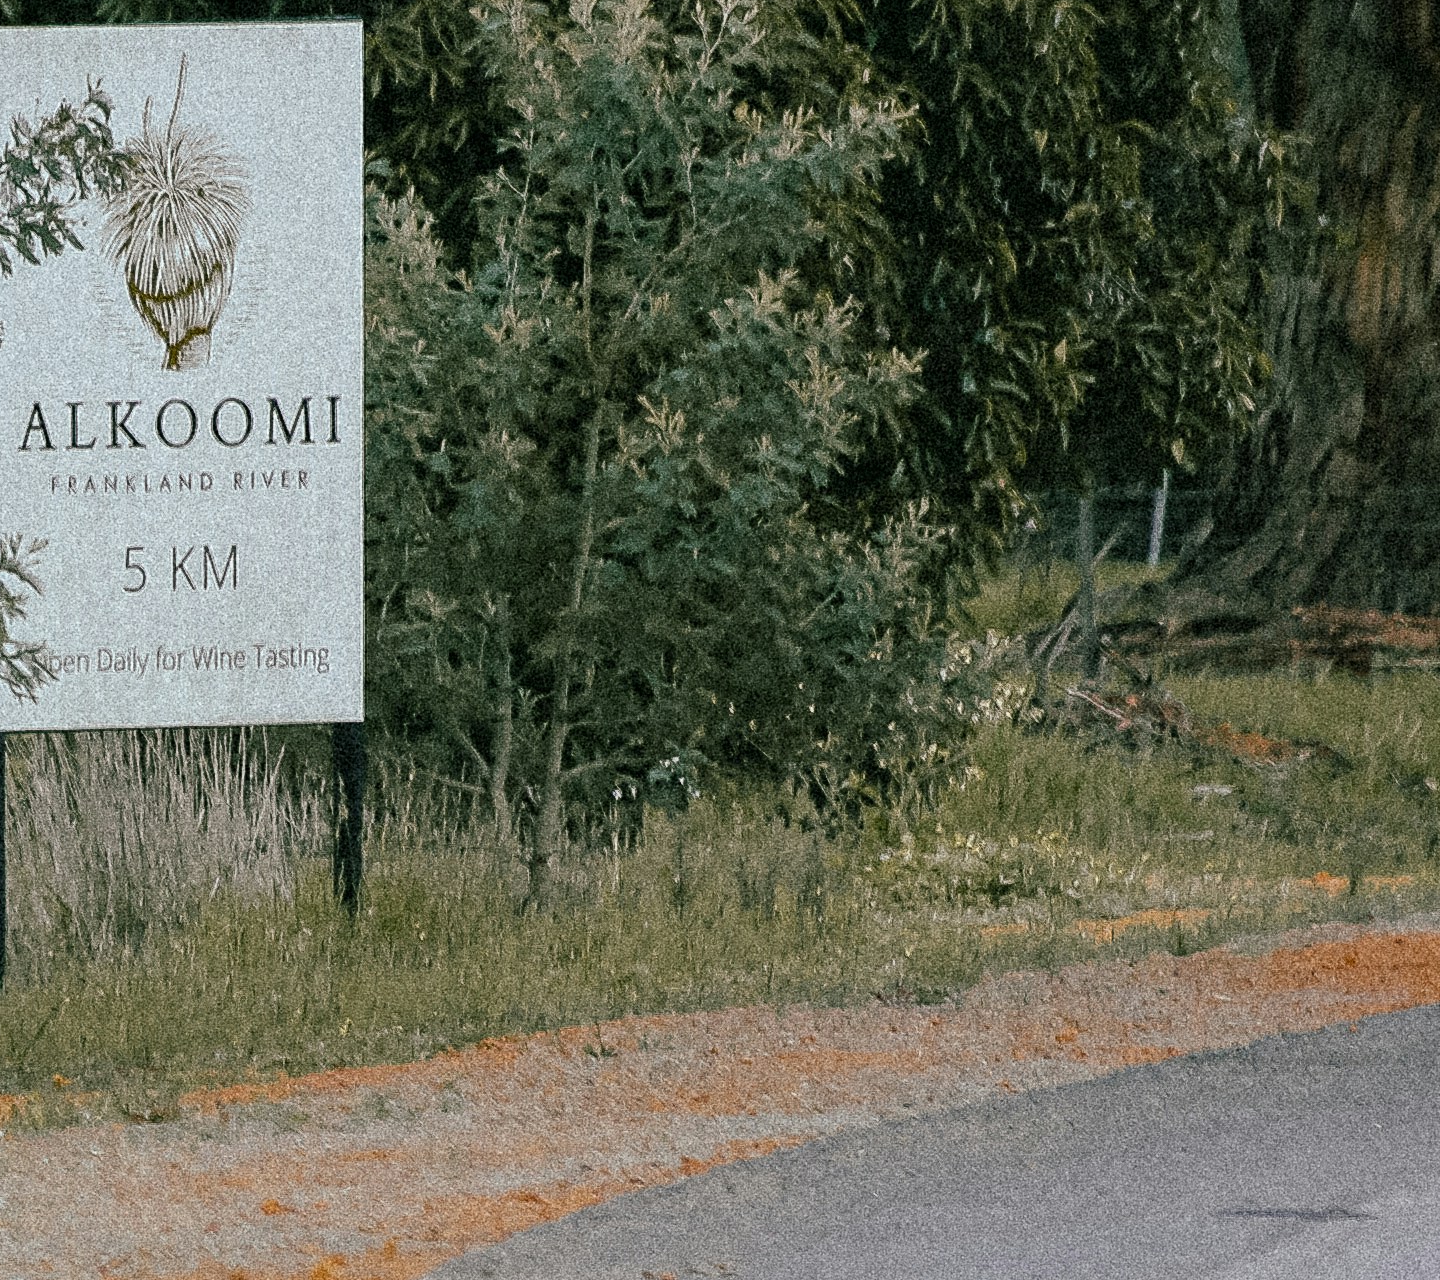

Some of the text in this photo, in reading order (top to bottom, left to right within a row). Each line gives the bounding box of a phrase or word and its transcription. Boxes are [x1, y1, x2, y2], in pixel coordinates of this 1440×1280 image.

[19, 394, 342, 452] ALKOOMI
[50, 469, 310, 495] FRANKLAND RIVER
[122, 545, 238, 592] 5 KM
[33, 643, 330, 678] pen Daily for Wine Tasting
